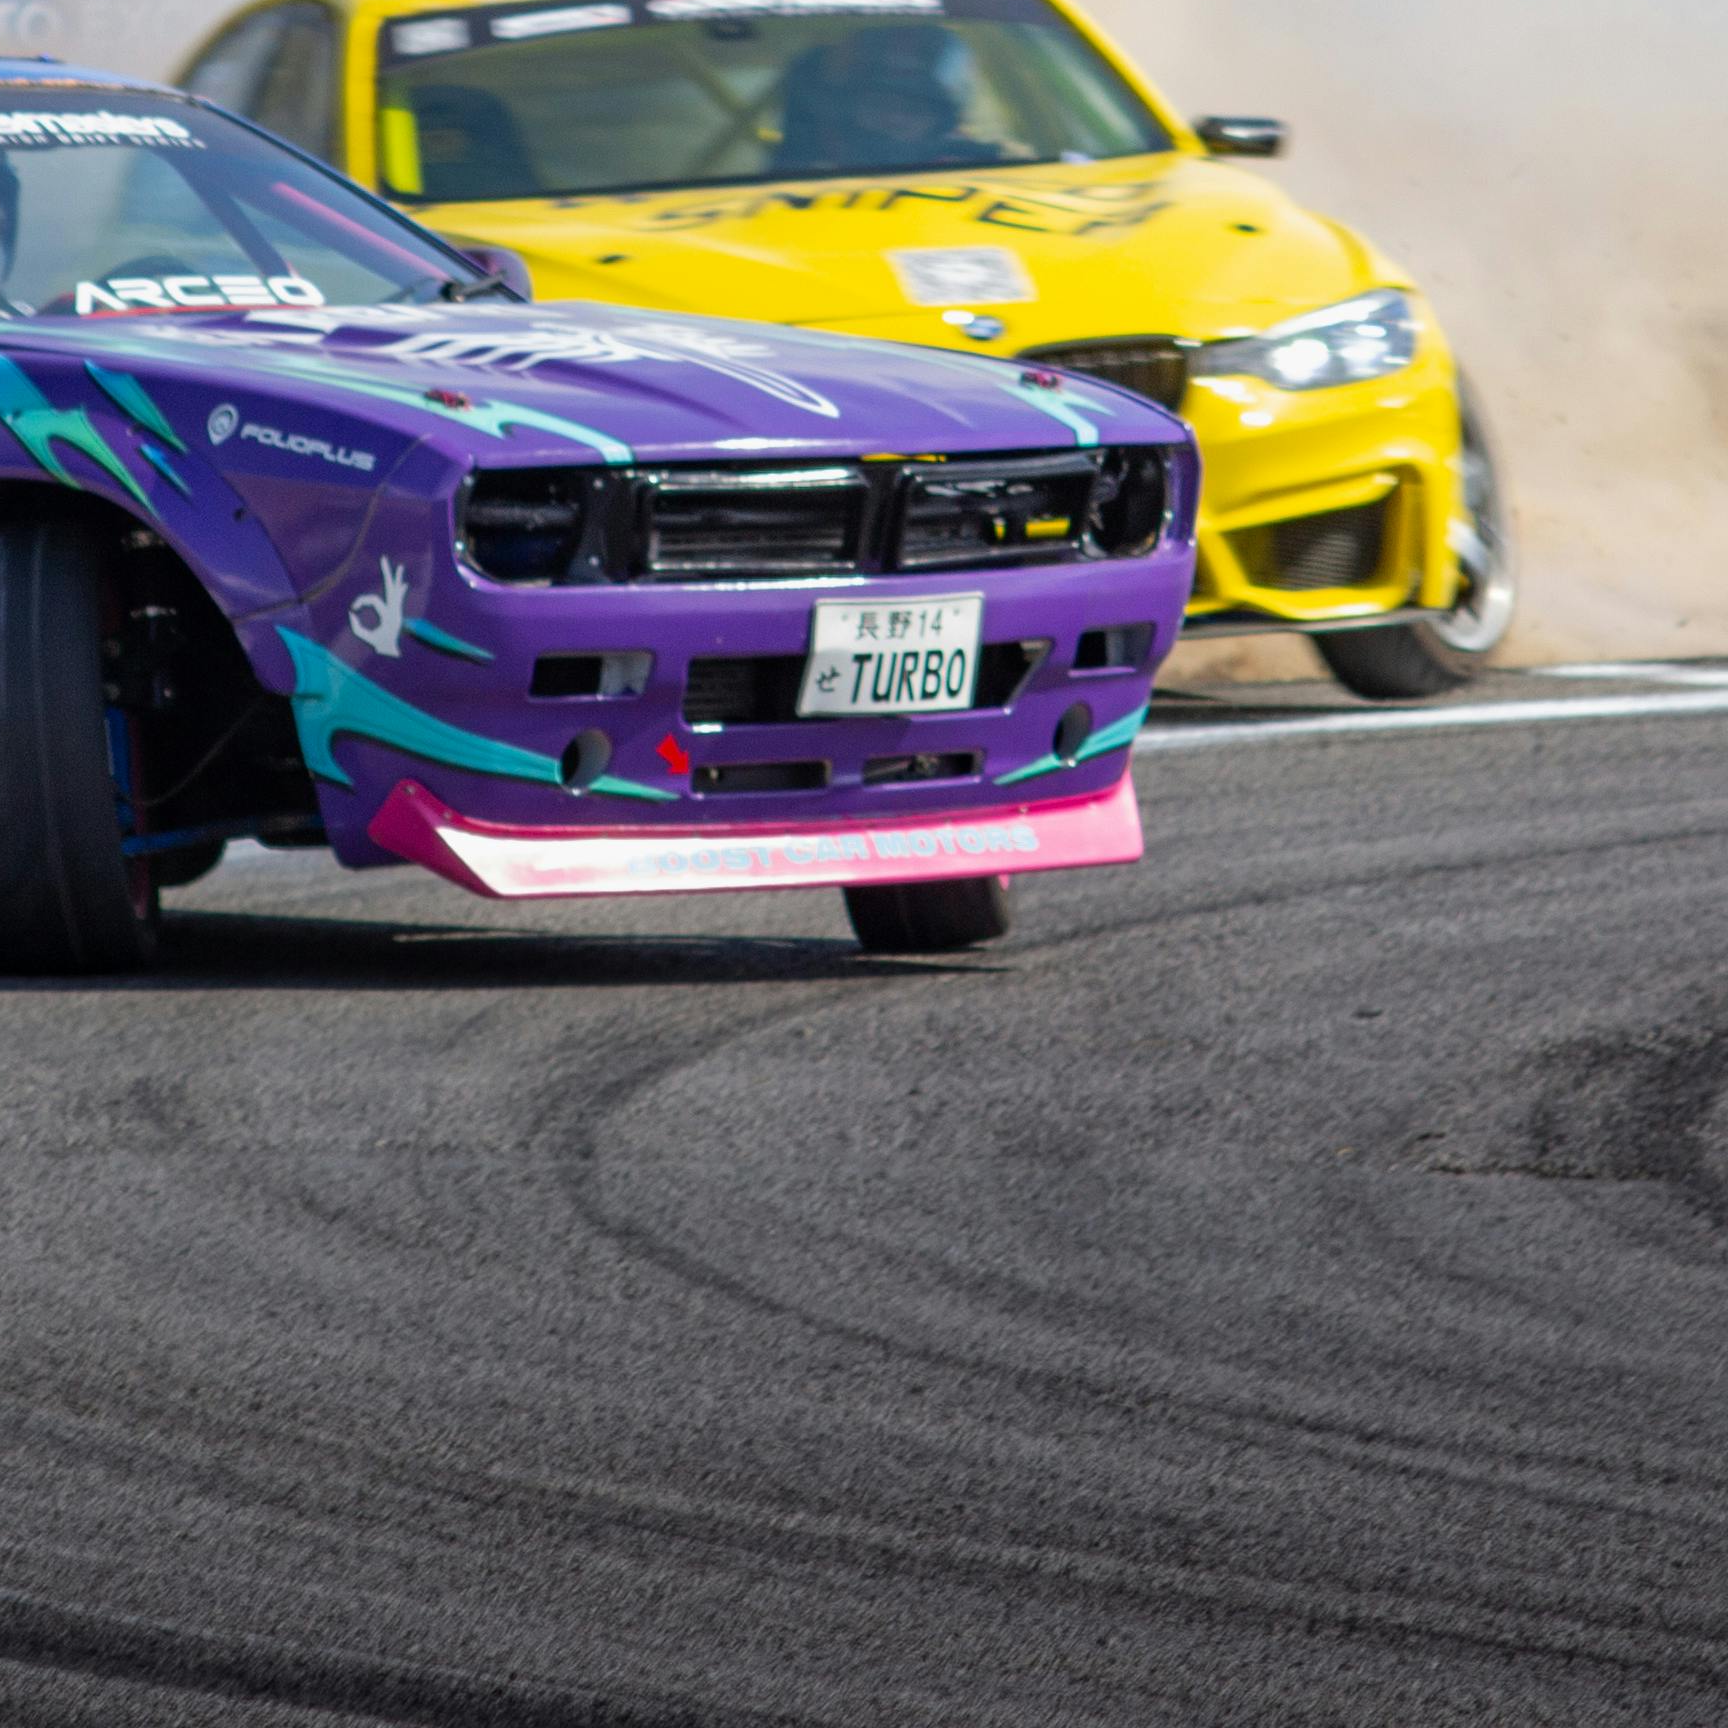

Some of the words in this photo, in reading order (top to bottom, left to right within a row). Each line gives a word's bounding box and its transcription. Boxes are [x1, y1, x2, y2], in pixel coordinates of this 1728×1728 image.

[74, 274, 326, 316] ARCEO
[241, 423, 376, 472] FOLIOPLUS
[815, 665, 841, 693] せ
[849, 647, 967, 705] TURBO
[783, 832, 867, 867] CAR
[868, 822, 1040, 860] MOTORS
